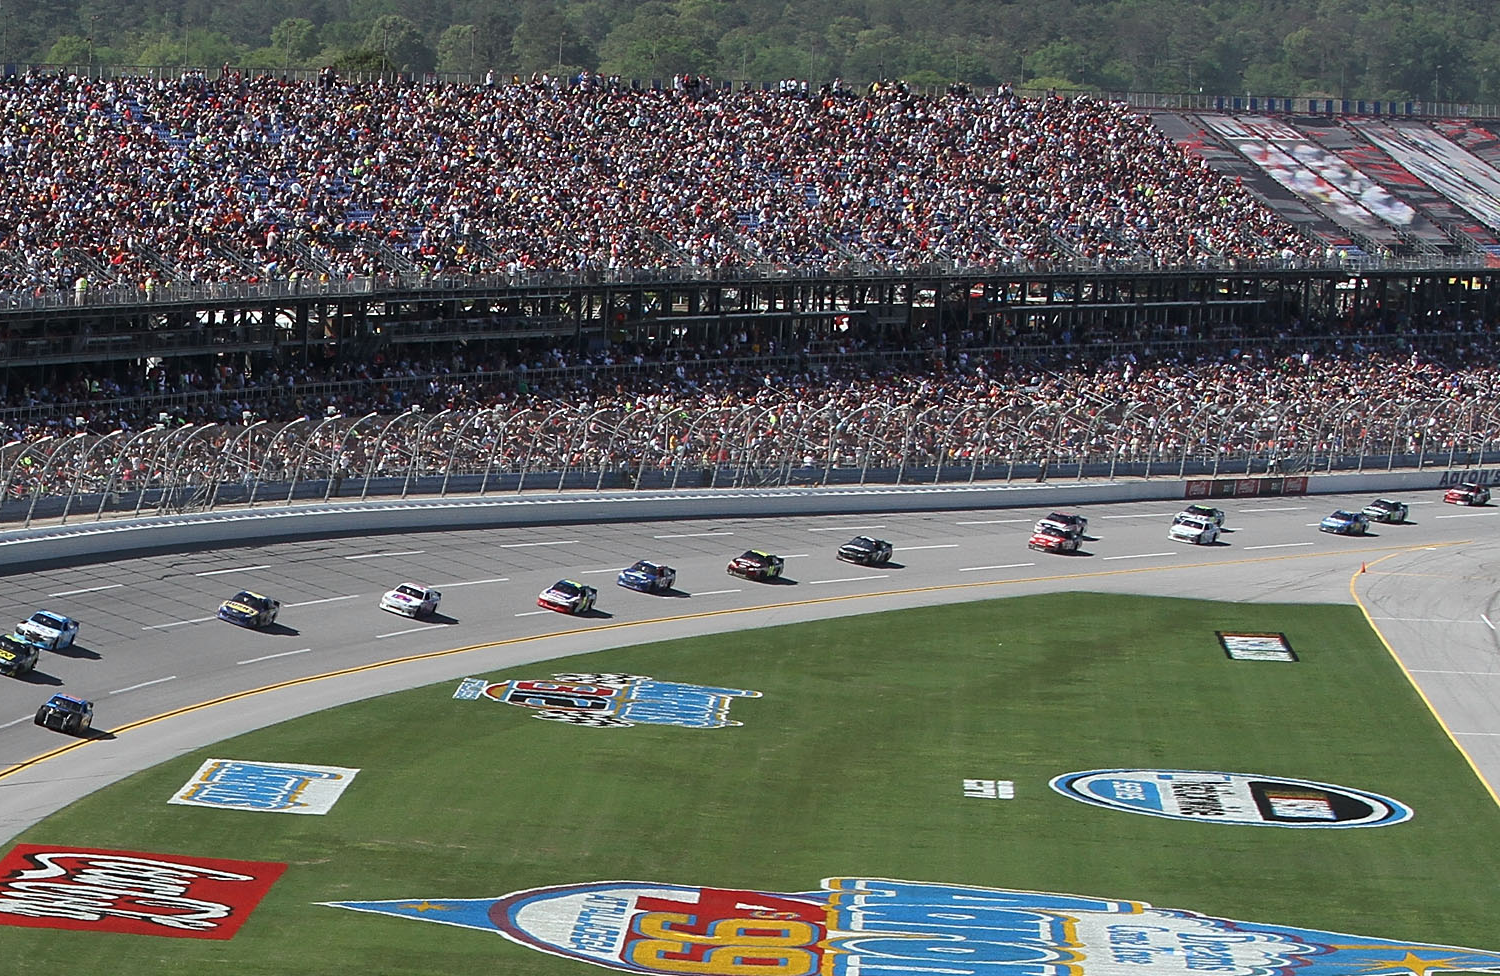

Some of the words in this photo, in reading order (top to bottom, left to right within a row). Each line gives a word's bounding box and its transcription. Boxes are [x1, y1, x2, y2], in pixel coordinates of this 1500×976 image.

[622, 680, 760, 726] Aaron's
[186, 763, 339, 810] Aaron's
[568, 903, 626, 954] TALLADEGA
[1106, 924, 1170, 945] Come
[1109, 945, 1174, 965] True
[1176, 932, 1256, 972] Dreams
